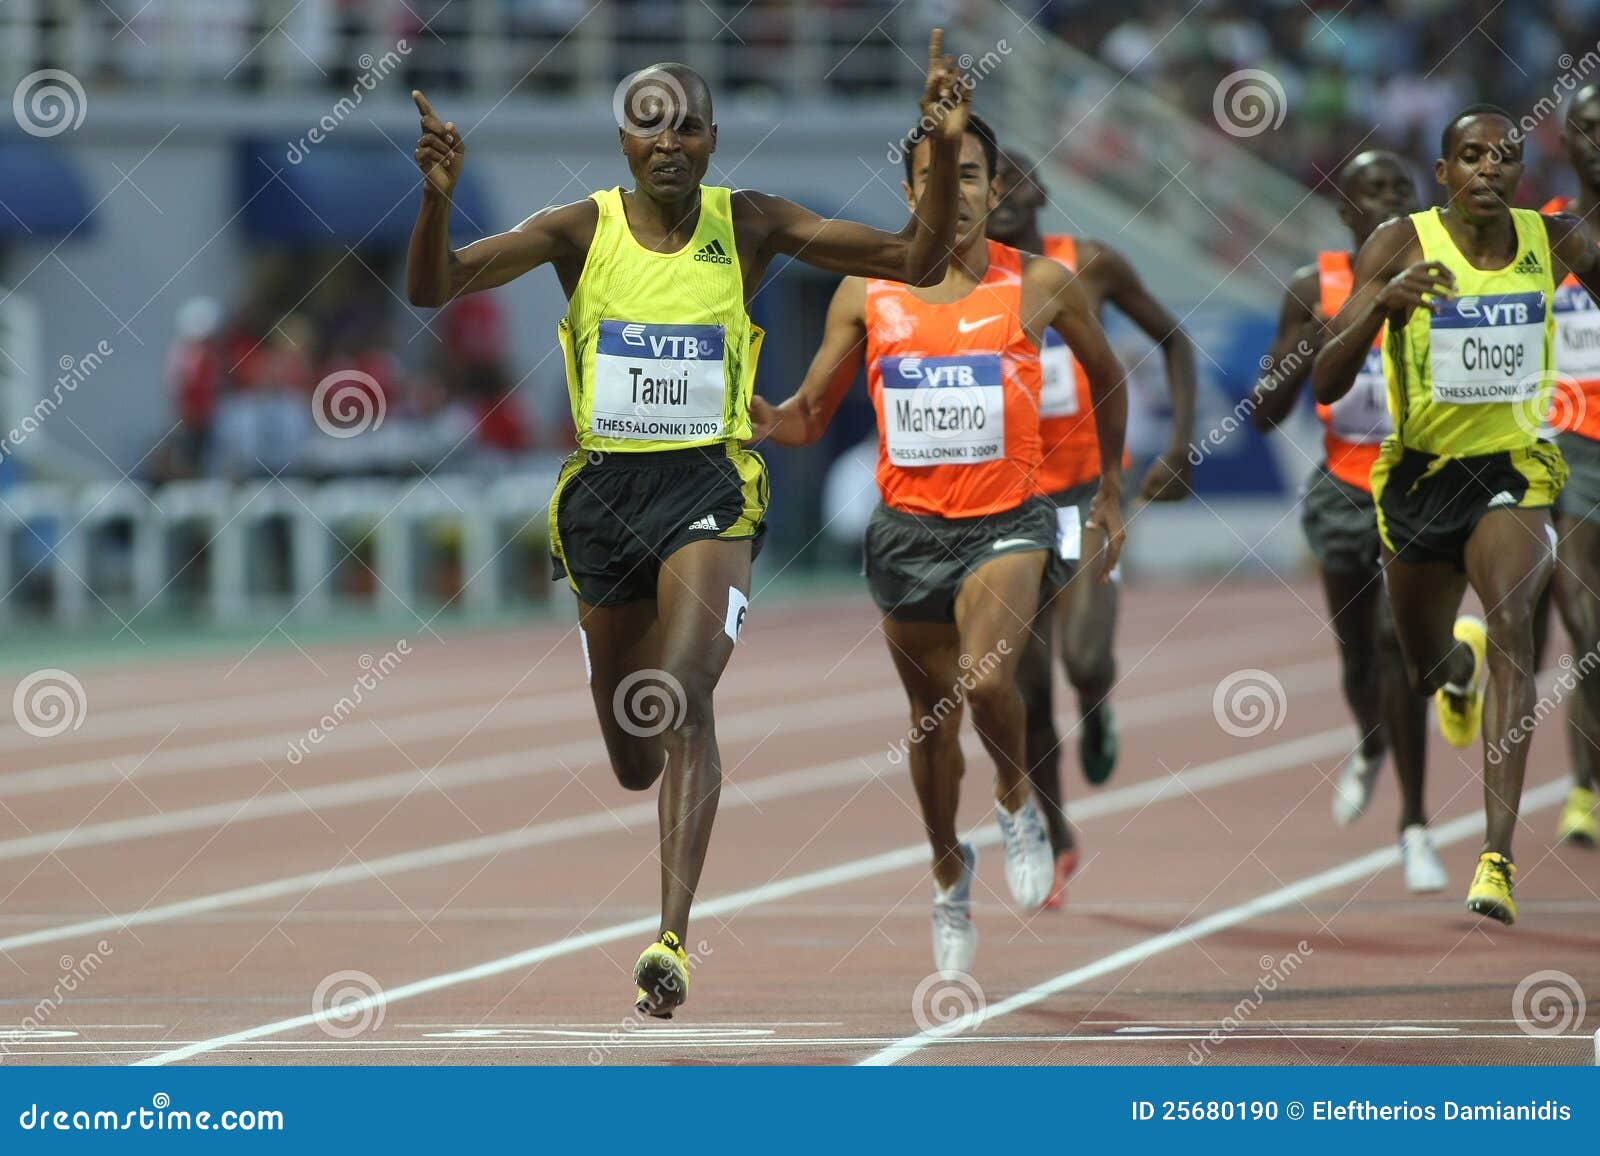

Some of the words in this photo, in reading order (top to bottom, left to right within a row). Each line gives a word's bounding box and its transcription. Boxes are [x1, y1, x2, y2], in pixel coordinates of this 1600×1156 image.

[693, 253, 732, 265] adidas
[1481, 302, 1530, 326] VTB
[649, 335, 699, 358] VTB
[1462, 337, 1524, 376] Choge
[628, 367, 688, 405] Tanui
[924, 365, 974, 388] VTB
[596, 418, 686, 435] THESSALONIKI
[689, 422, 718, 435] 2009
[896, 399, 985, 433] Manzano
[970, 443, 999, 458] 2009
